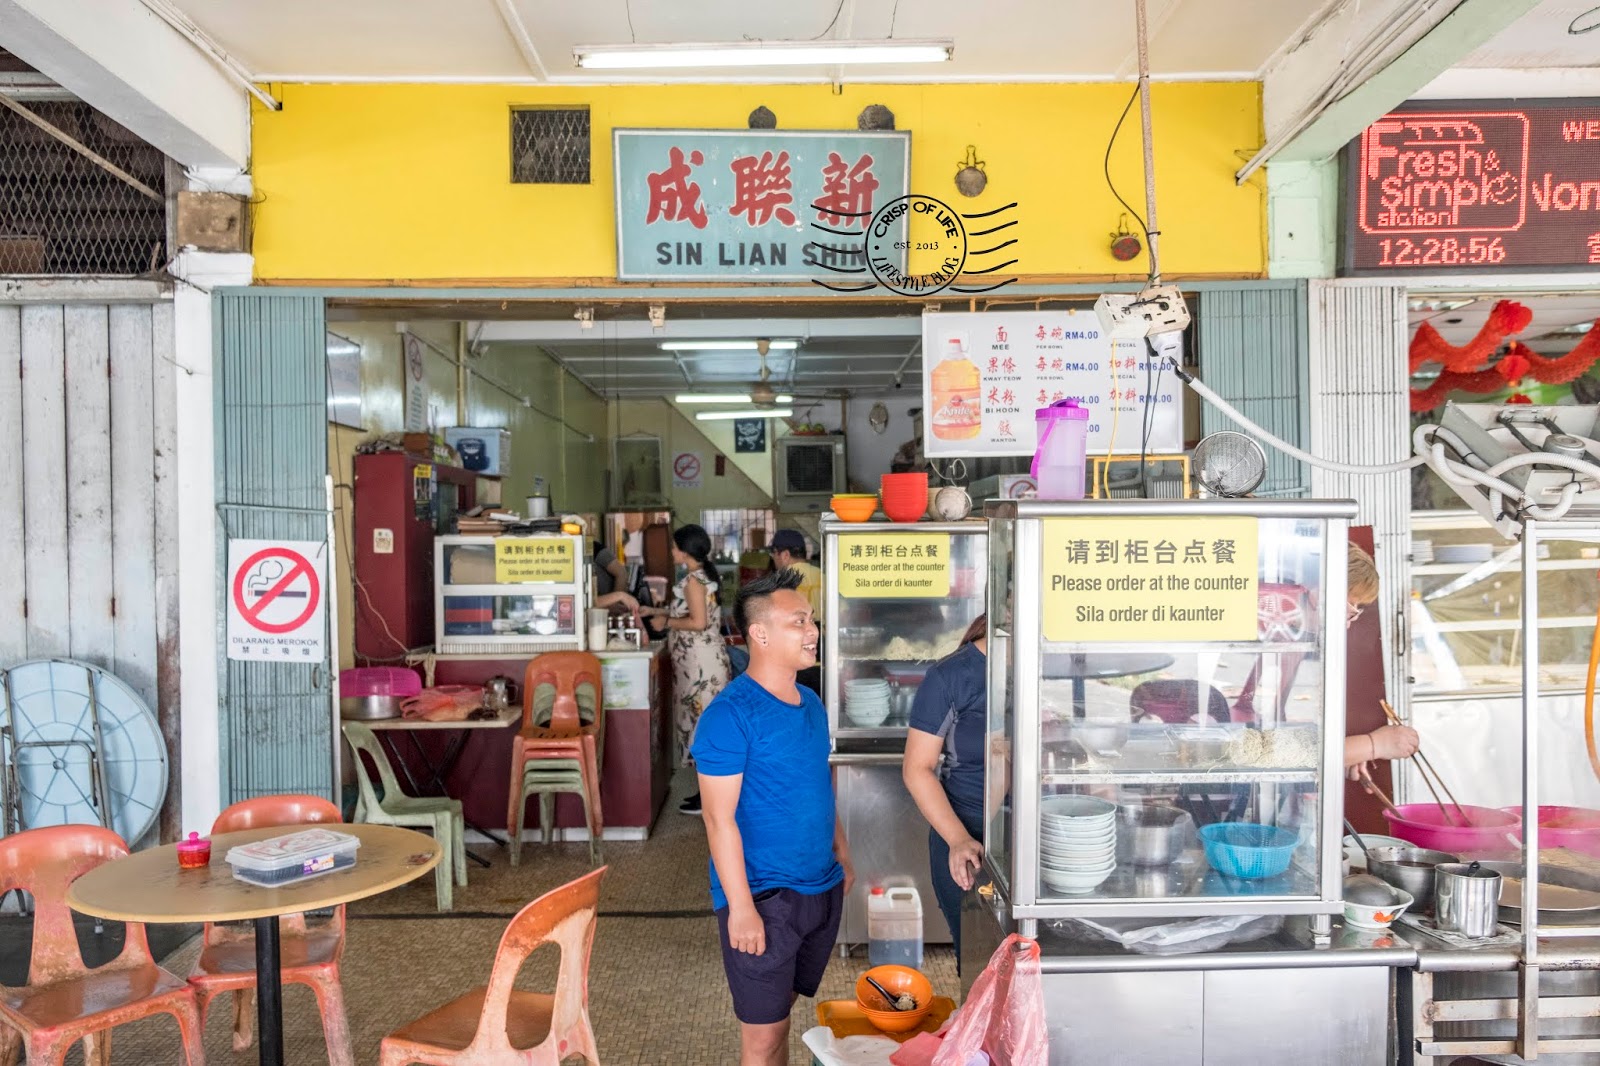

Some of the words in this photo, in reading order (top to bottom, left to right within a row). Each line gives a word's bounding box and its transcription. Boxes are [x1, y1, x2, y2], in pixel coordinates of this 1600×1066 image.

[1368, 122, 1482, 180] Fresh
[1484, 150, 1500, 170] &
[1378, 207, 1452, 227] station
[657, 242, 702, 266] SIN
[718, 242, 787, 266] LIAN
[802, 243, 867, 266] SHIN
[1378, 236, 1506, 266] 12:28:56
[1065, 331, 1099, 339] RM4.00
[1066, 362, 1099, 371] RM4.00
[850, 544, 938, 557] 请到柜台点餐
[1065, 539, 1237, 565] 请到柜台点餐
[843, 562, 869, 571] Please
[871, 562, 891, 571] order
[893, 563, 901, 571] at
[902, 562, 914, 571] the
[916, 563, 945, 571] counter
[855, 579, 870, 587] Sila
[872, 579, 893, 587] order
[894, 579, 902, 587] di
[903, 579, 933, 587] kaunter
[1052, 574, 1102, 591] Please
[1106, 574, 1146, 591] order
[1149, 575, 1164, 591] at
[1167, 574, 1190, 590] the
[1194, 575, 1249, 590] counter
[1076, 605, 1104, 622] Sila
[1108, 605, 1149, 622] order
[1152, 605, 1165, 621] di
[1169, 605, 1225, 621] kaunter
[232, 637, 275, 645] DILARANG
[277, 638, 319, 646] MEROKOK
